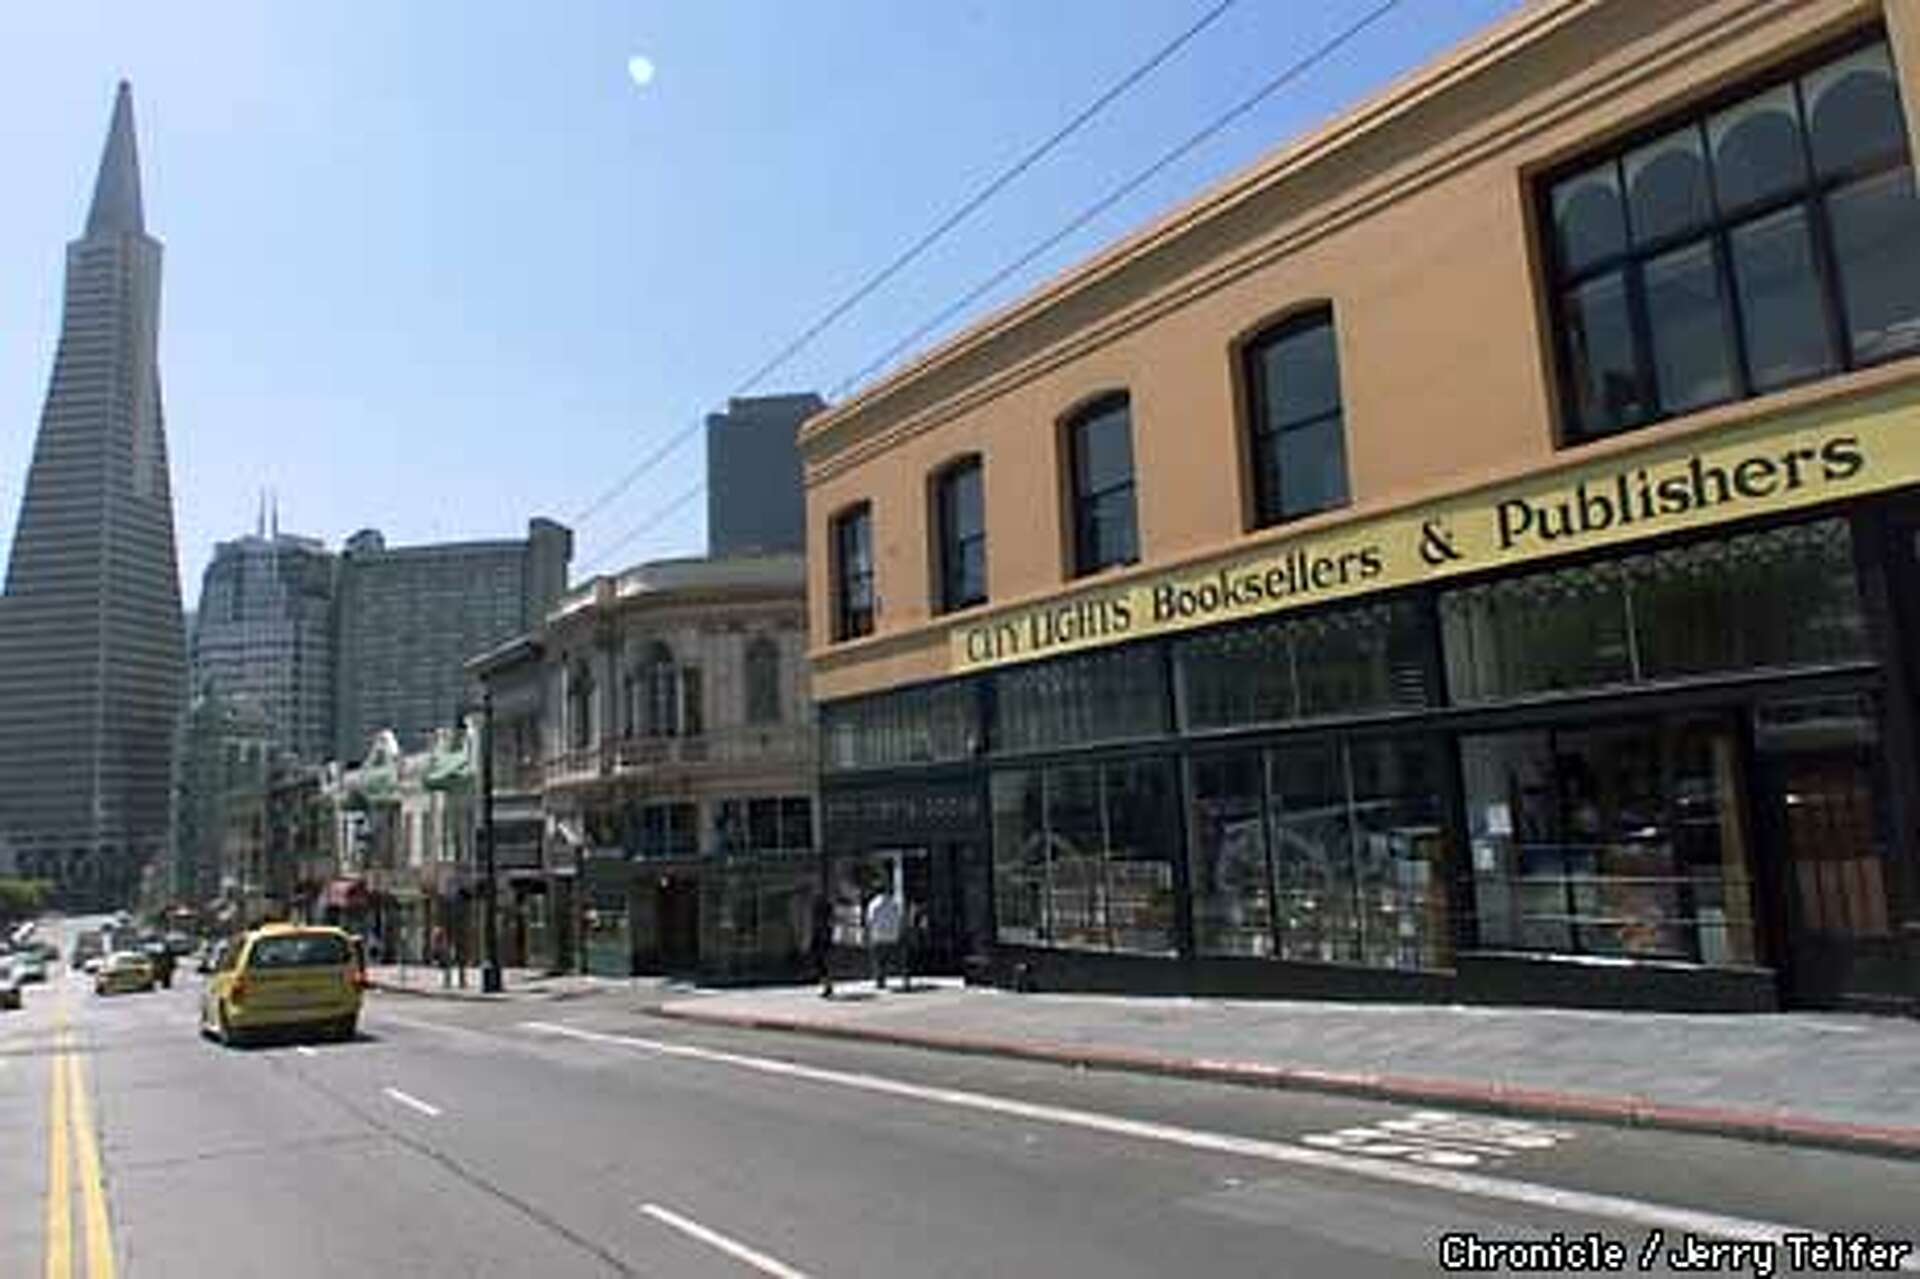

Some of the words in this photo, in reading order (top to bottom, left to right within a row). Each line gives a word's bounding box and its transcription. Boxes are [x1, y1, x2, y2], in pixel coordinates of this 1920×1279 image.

[966, 615, 1024, 662] CITY
[1028, 596, 1132, 650] LIGHTS
[1152, 546, 1384, 623] Booksellers
[1418, 519, 1464, 565] &
[1496, 434, 1867, 550] Publishers
